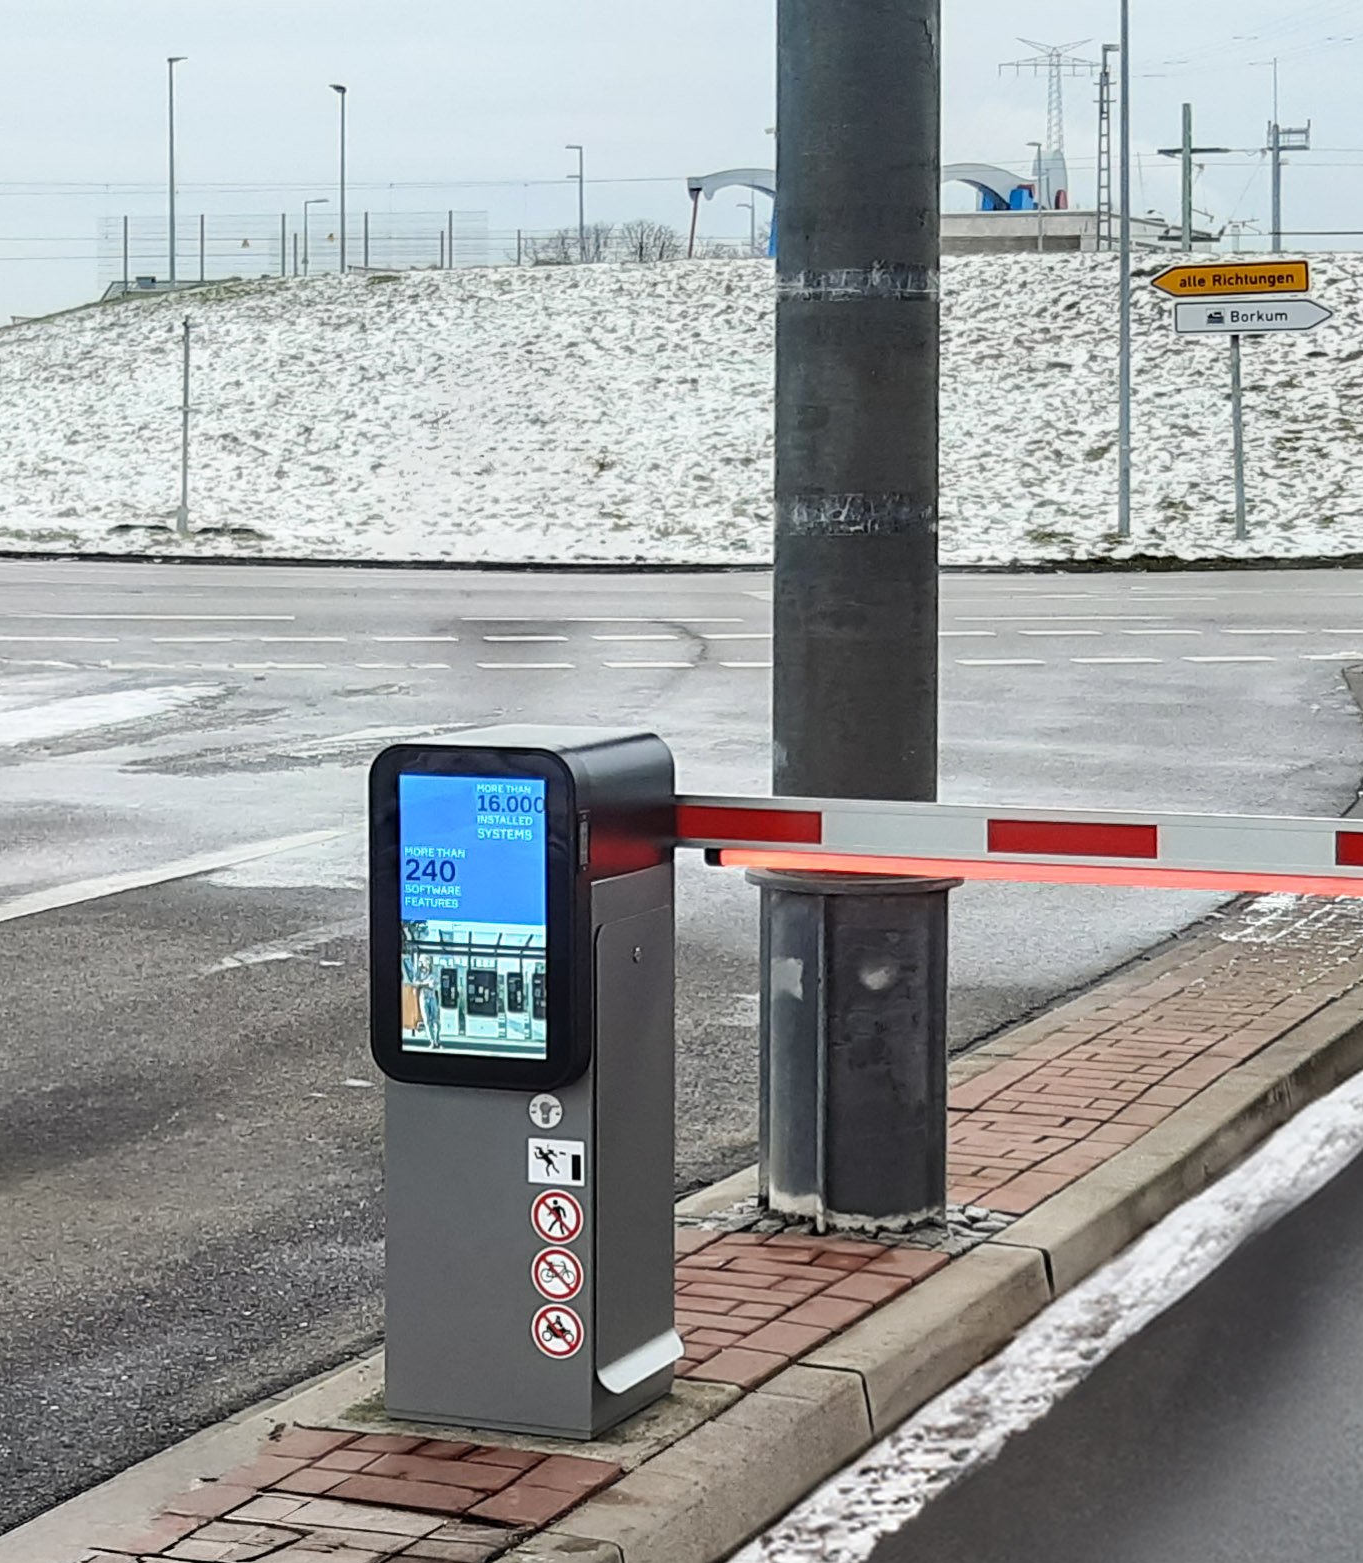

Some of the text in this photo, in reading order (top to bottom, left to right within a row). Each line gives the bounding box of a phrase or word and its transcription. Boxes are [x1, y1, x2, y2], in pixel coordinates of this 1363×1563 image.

[1179, 273, 1295, 288] alle Richtungen
[1230, 310, 1288, 323] Borkum
[476, 784, 531, 794] MORE THAN
[477, 795, 545, 813] 16.000
[476, 815, 533, 826] INSTALLED
[476, 828, 533, 841] SYSTEMS
[404, 846, 466, 859] MORE THAN
[405, 858, 457, 882] 240
[404, 884, 461, 897] SOFTWARE
[404, 896, 459, 909] FEATURES
